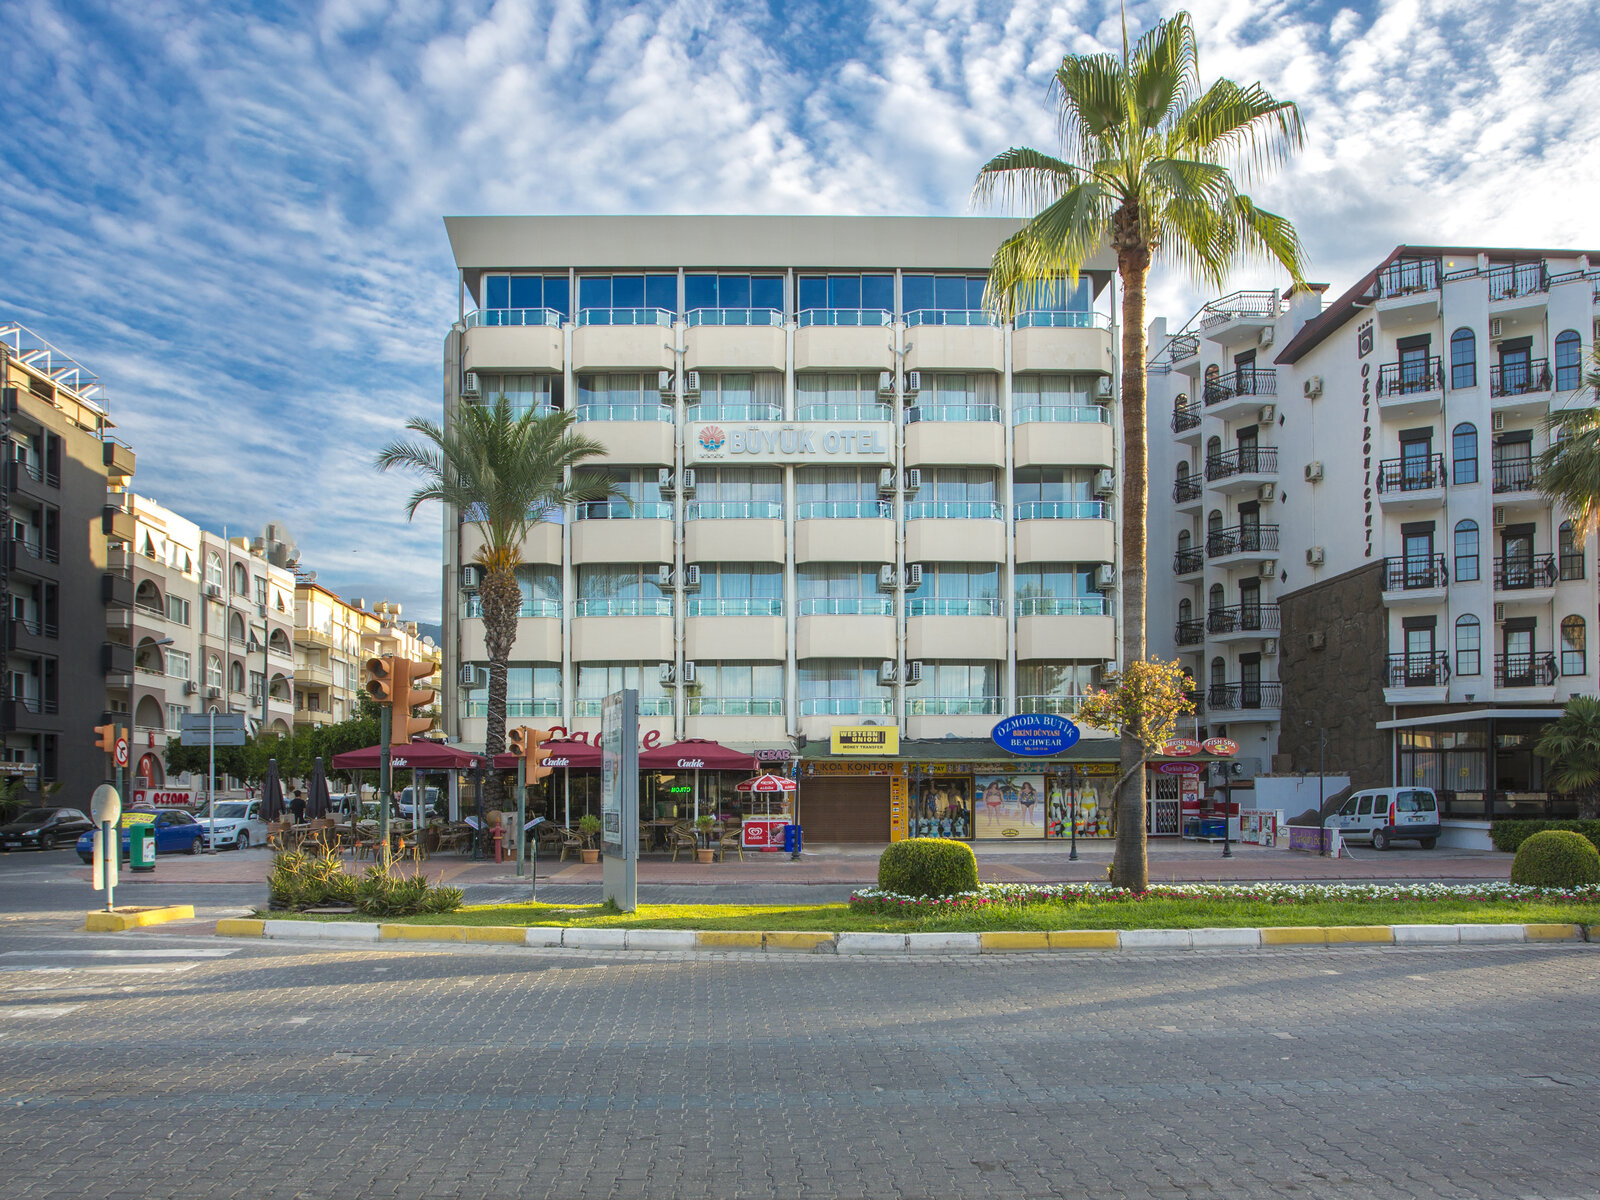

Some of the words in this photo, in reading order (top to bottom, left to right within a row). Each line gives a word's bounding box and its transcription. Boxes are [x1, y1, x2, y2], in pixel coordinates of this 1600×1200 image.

[1360, 362, 1371, 423] Otel
[730, 424, 816, 455] BÜYÜK
[823, 430, 886, 455] OTEL
[1362, 425, 1373, 558] Boulevard
[997, 716, 1040, 737] ÖZMODA
[1043, 716, 1074, 738] BUTİK
[1011, 738, 1062, 746] BEACHWEAR
[1185, 740, 1200, 748] BATH
[1223, 740, 1236, 748] SPA
[754, 750, 791, 761] KEBAB
[542, 757, 570, 767] Cadde
[677, 758, 705, 768] Cadde
[847, 763, 894, 771] KONTOR
[153, 792, 190, 805] eczane
